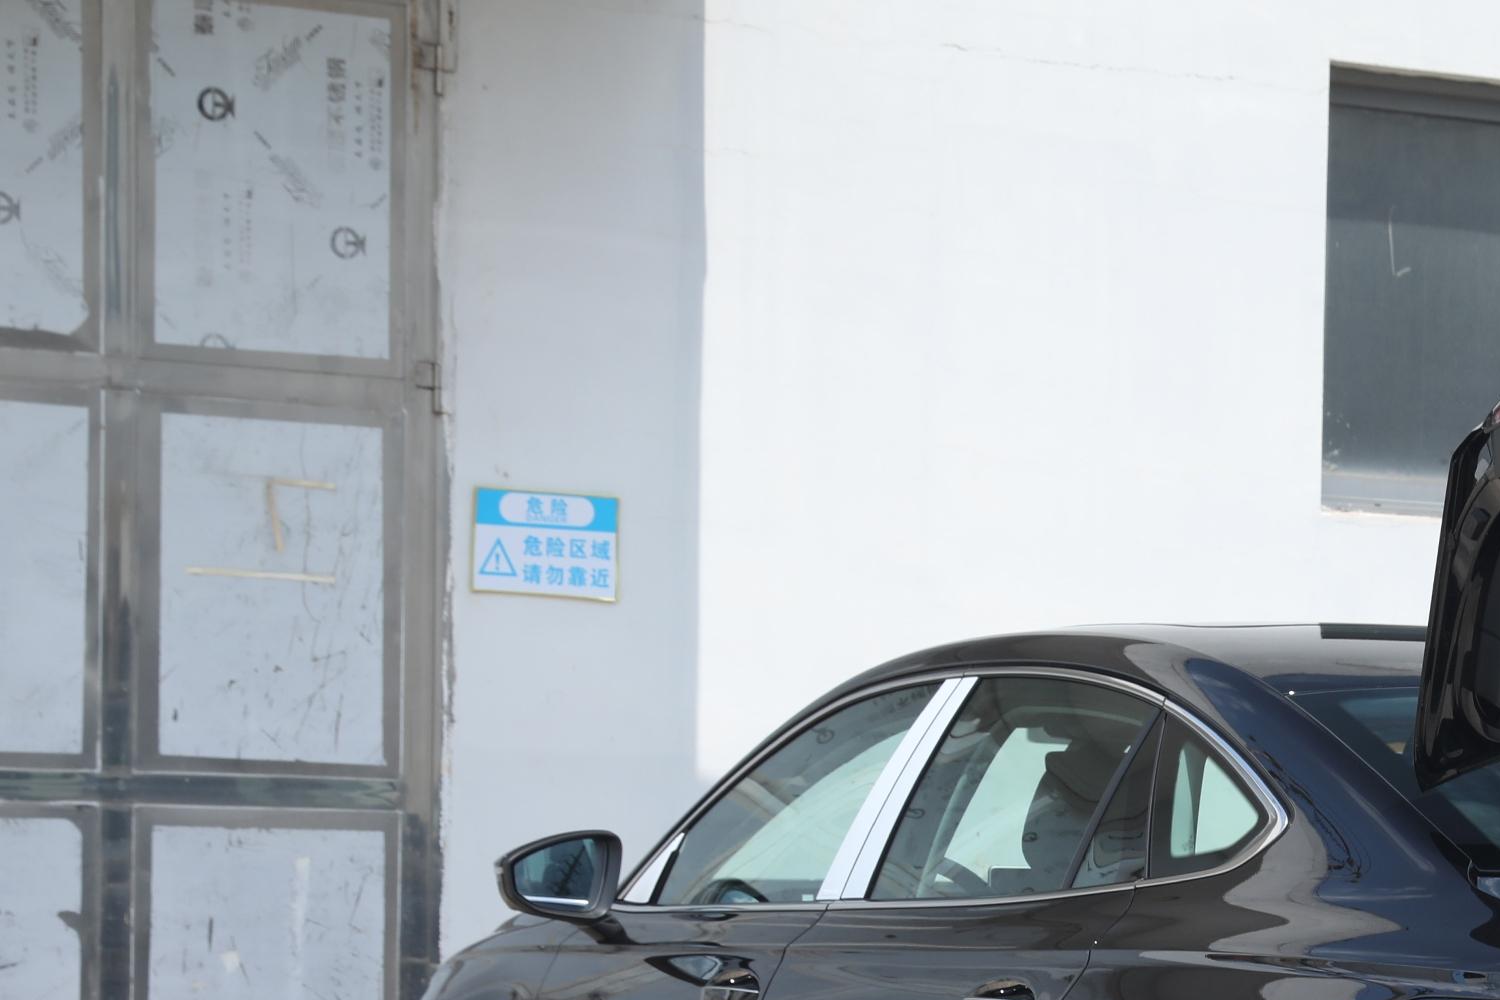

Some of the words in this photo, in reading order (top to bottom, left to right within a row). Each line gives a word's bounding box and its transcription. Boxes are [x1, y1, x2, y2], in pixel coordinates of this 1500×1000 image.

[527, 496, 568, 515] 危险
[523, 535, 611, 560] 危险区域
[523, 564, 610, 588] 请勿靠近
